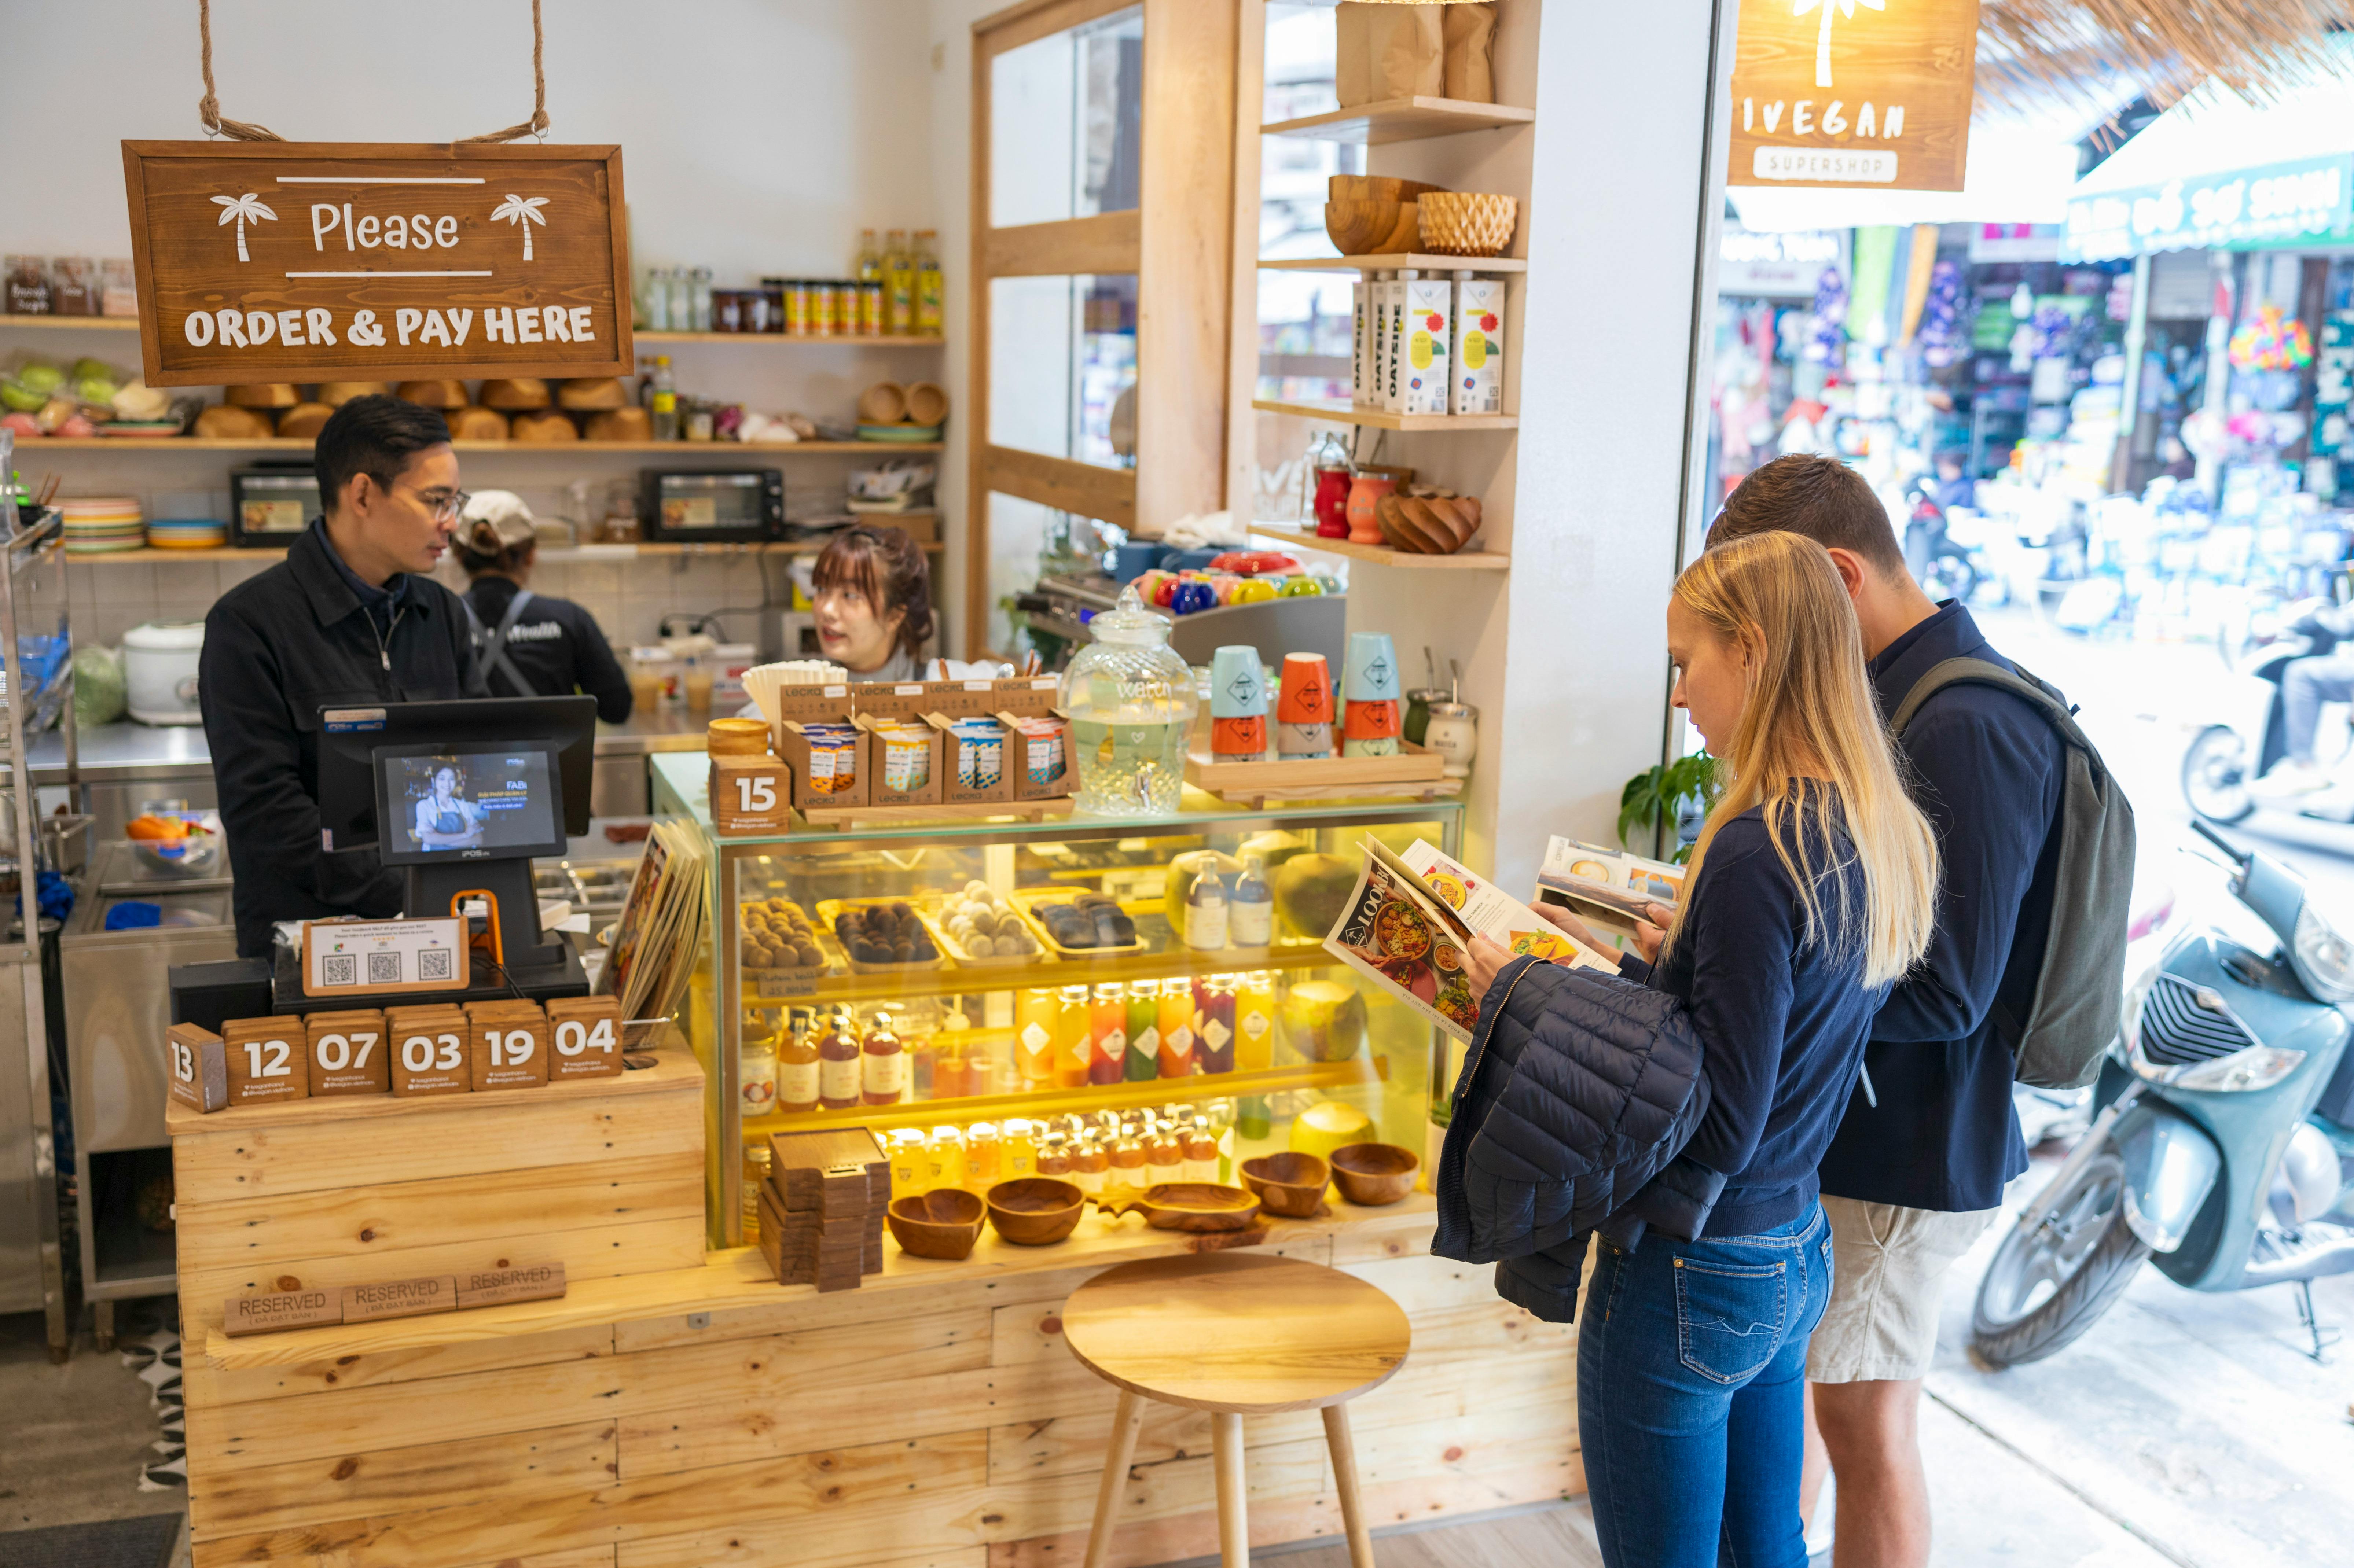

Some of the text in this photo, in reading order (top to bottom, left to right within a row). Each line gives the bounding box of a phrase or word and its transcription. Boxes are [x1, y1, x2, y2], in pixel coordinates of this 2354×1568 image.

[1743, 97, 1905, 139] IVEGAN
[1770, 155, 1883, 174] SUPERSHOP
[310, 203, 459, 251] Please
[184, 305, 596, 349] ORDER & PAY HERE
[1389, 303, 1401, 398] OATSIDE
[736, 777, 776, 812] 15
[317, 1032, 378, 1071] 07
[401, 1034, 462, 1072] 03
[484, 1029, 535, 1067] 19
[555, 1018, 616, 1056] 04
[172, 1041, 194, 1082] 13
[244, 1040, 291, 1078] 12
[355, 1279, 439, 1305] RESERVED
[470, 1266, 551, 1291] RESERVED
[240, 1292, 326, 1316] RESERVED
